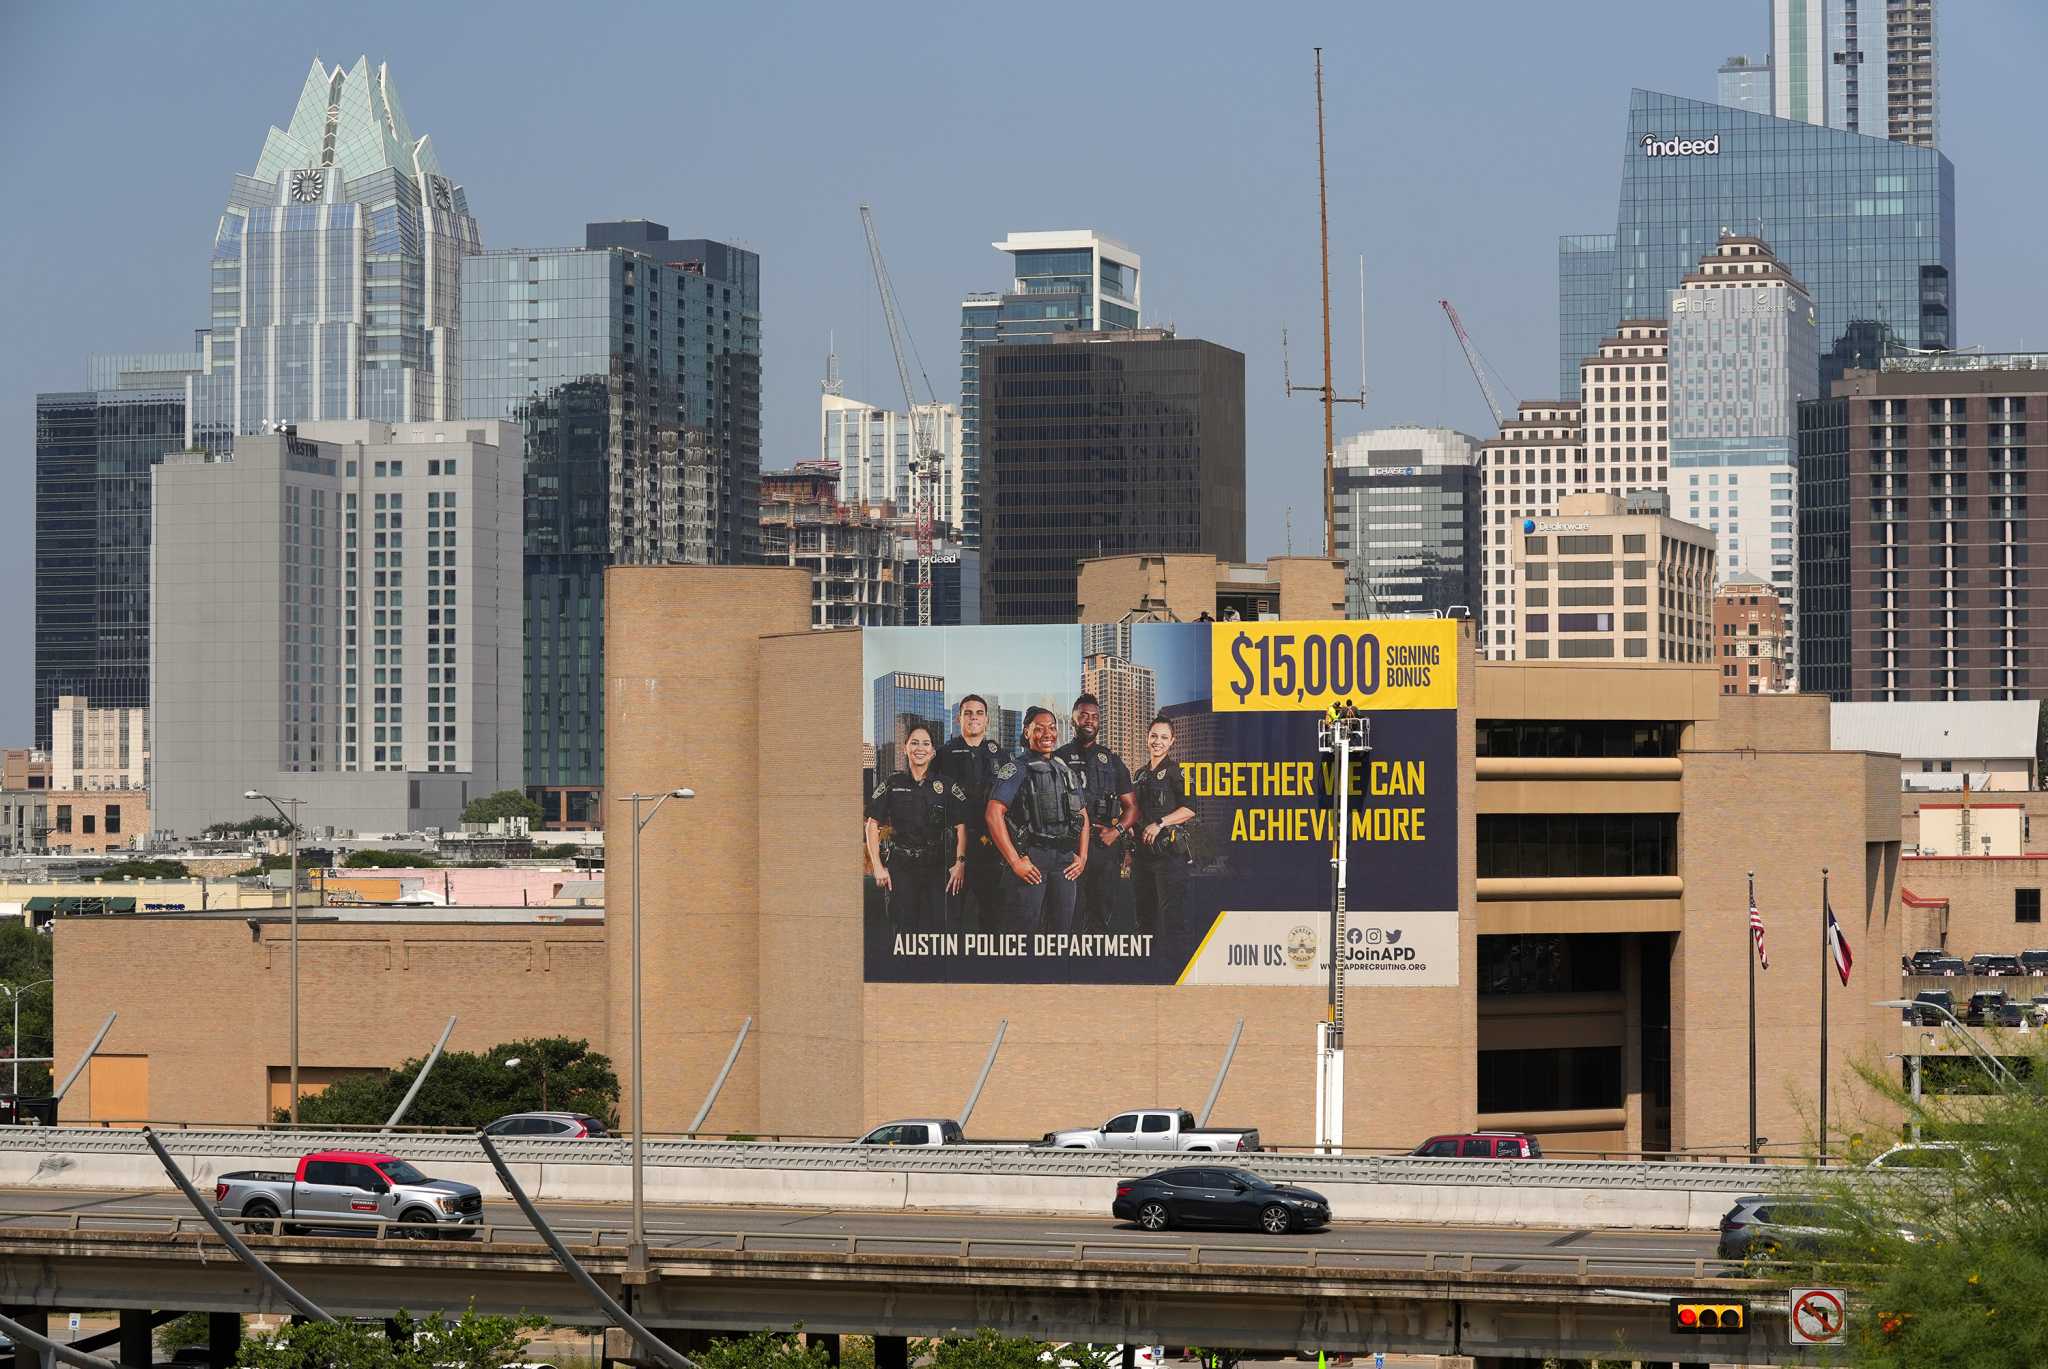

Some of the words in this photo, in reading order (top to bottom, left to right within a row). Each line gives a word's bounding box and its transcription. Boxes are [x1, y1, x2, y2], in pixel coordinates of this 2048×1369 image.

[1640, 133, 1719, 157] indeed
[1230, 631, 1380, 704] $15,000
[1386, 645, 1440, 666] SIGNING
[1386, 667, 1431, 688] BONUS
[1179, 762, 1314, 797] TOGETHER
[1370, 761, 1425, 796] CAN
[1352, 808, 1425, 841] MORE
[893, 933, 959, 956] AUSTIN
[965, 933, 1028, 957] POLICE
[1034, 934, 1154, 957] DEPARTMENT
[1228, 944, 1258, 966] JOIN
[1263, 944, 1287, 966] US.
